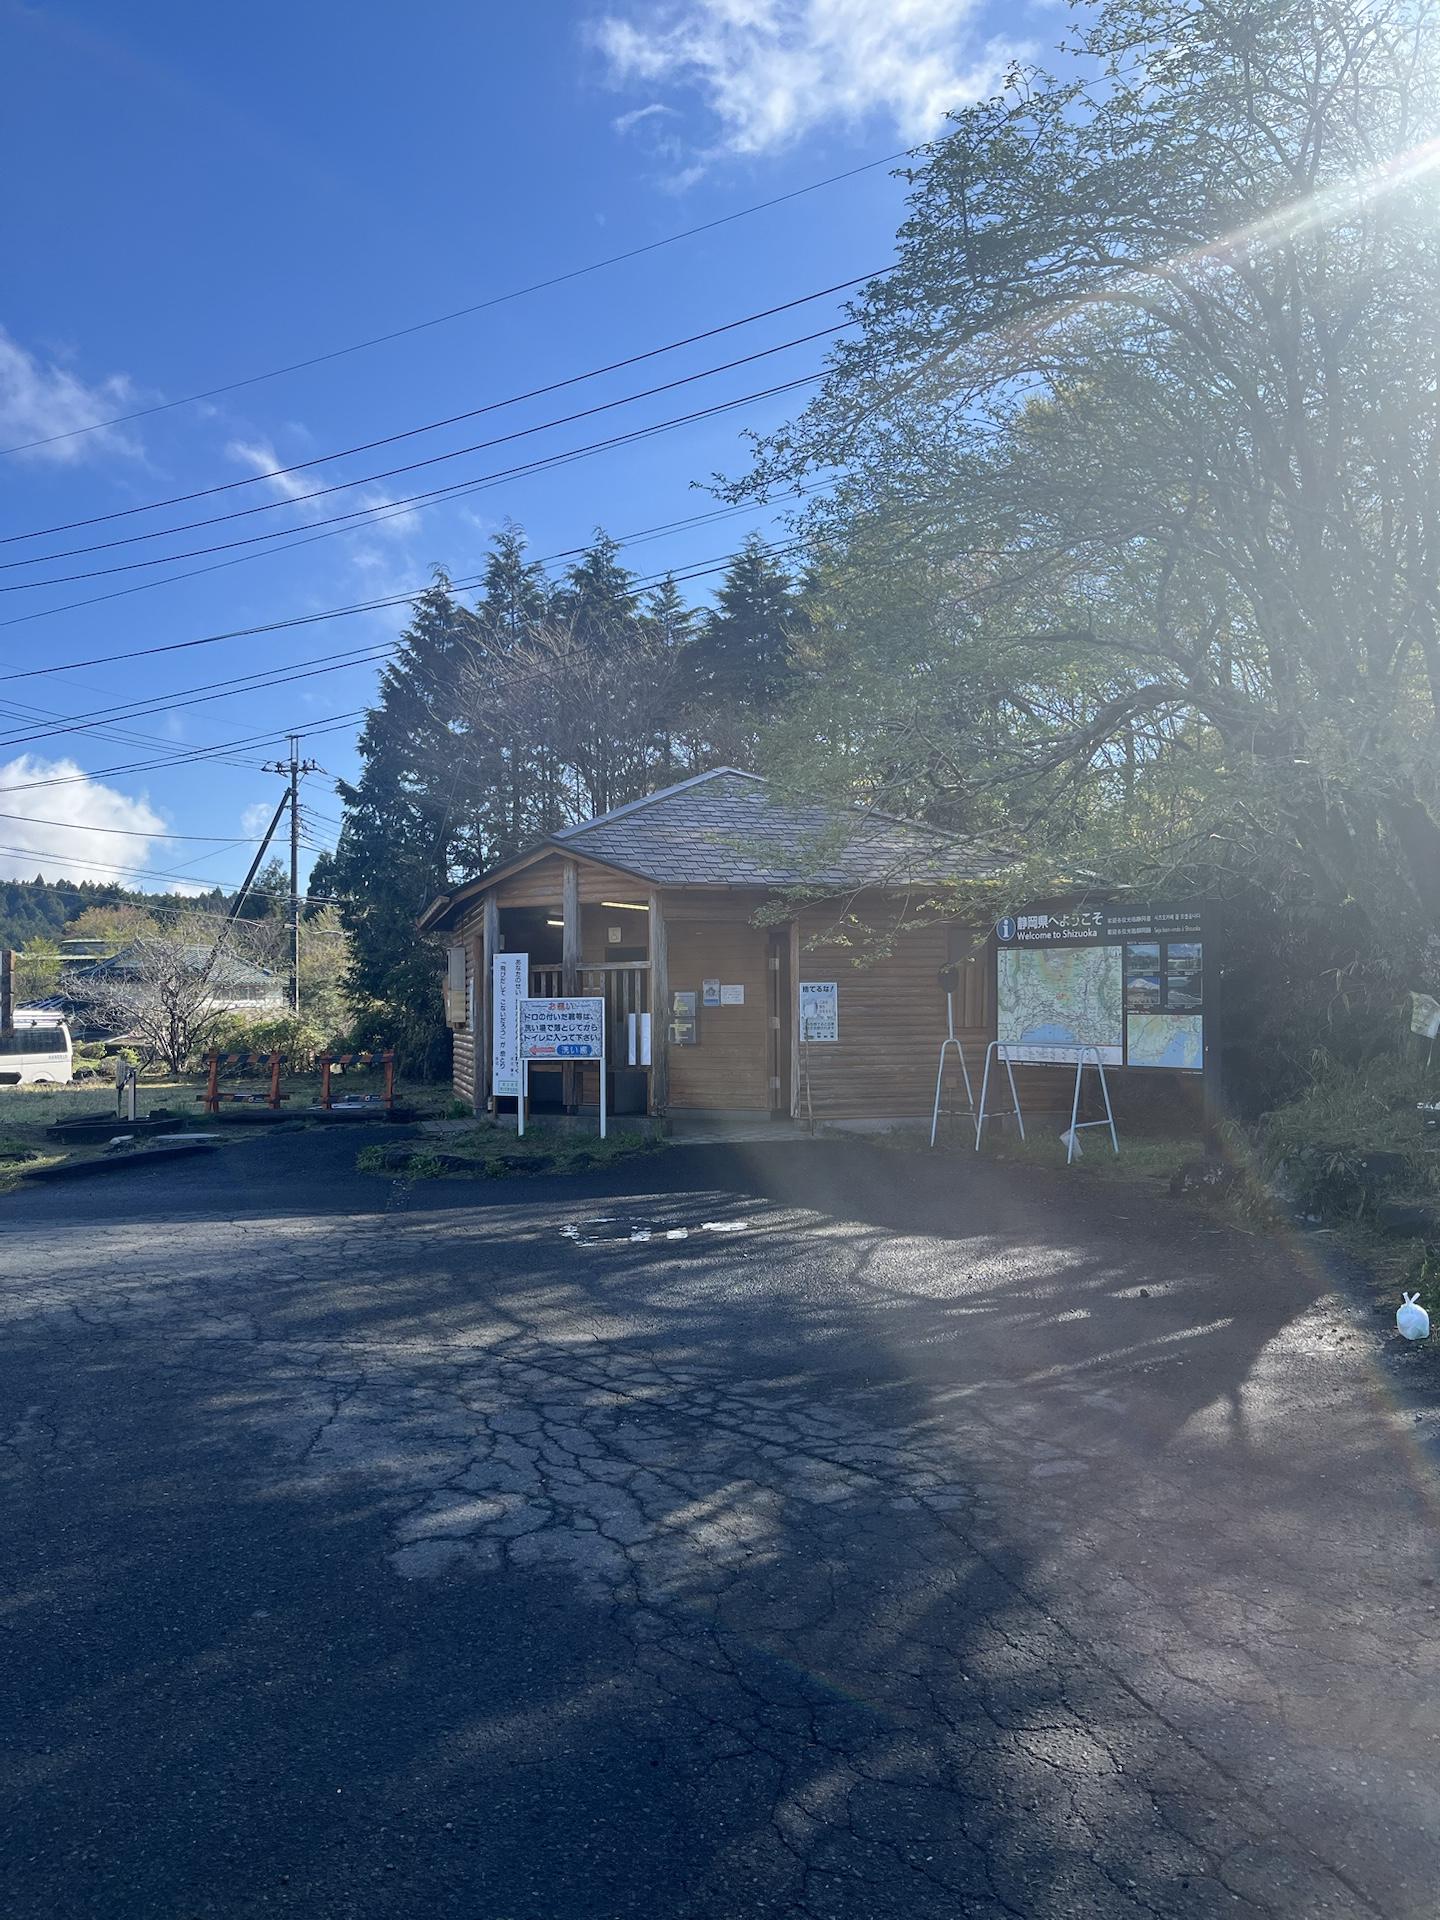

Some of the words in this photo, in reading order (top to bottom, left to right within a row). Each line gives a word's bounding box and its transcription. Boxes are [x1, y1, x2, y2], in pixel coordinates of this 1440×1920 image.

[1017, 912, 1103, 930] 静岡県へようこそ
[1016, 931, 1052, 940] Welcome
[1053, 931, 1061, 939] to
[1062, 927, 1098, 938] Shizuoka
[524, 1024, 598, 1032] 洗い場で落としてから
